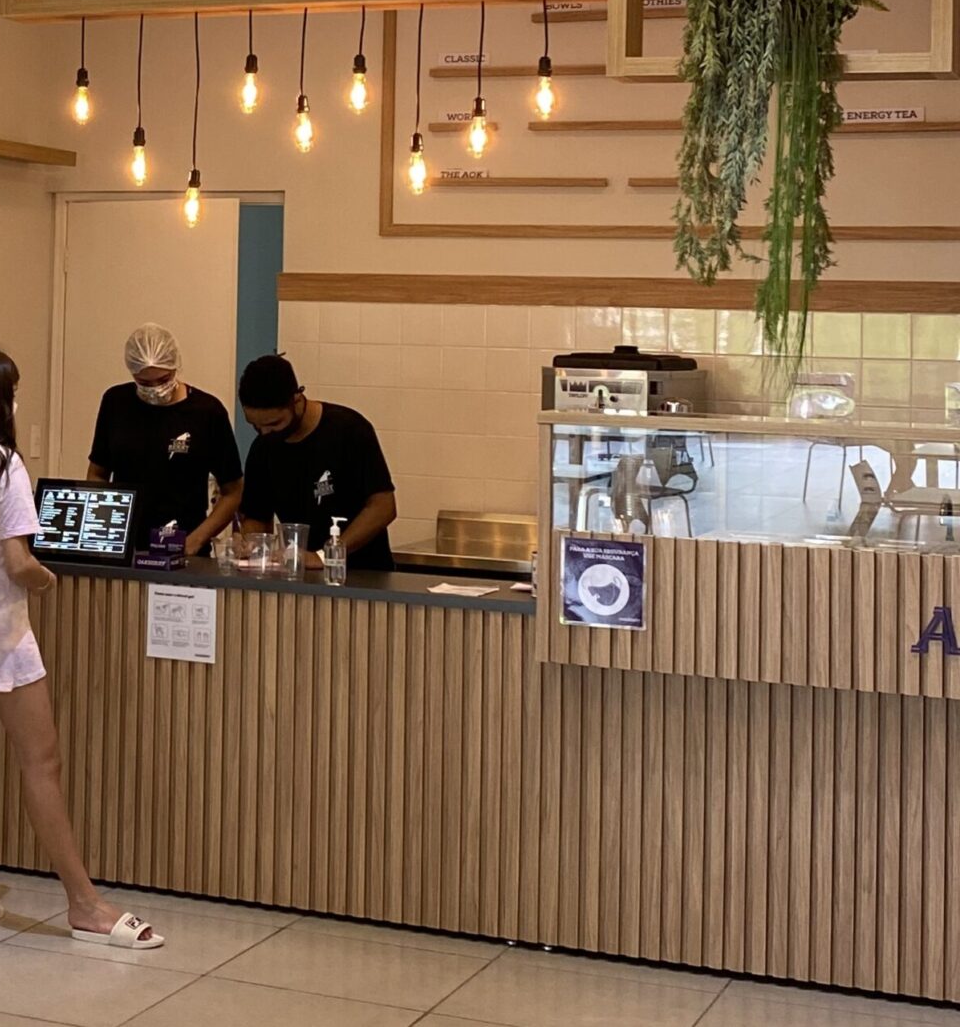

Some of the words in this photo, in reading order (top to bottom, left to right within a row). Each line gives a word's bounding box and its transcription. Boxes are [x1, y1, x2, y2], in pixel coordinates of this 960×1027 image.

[444, 55, 485, 63] CLASSIC
[847, 111, 892, 120] ENERGY
[895, 110, 917, 119] TEA
[440, 171, 460, 179] THE
[911, 606, 960, 655] A
